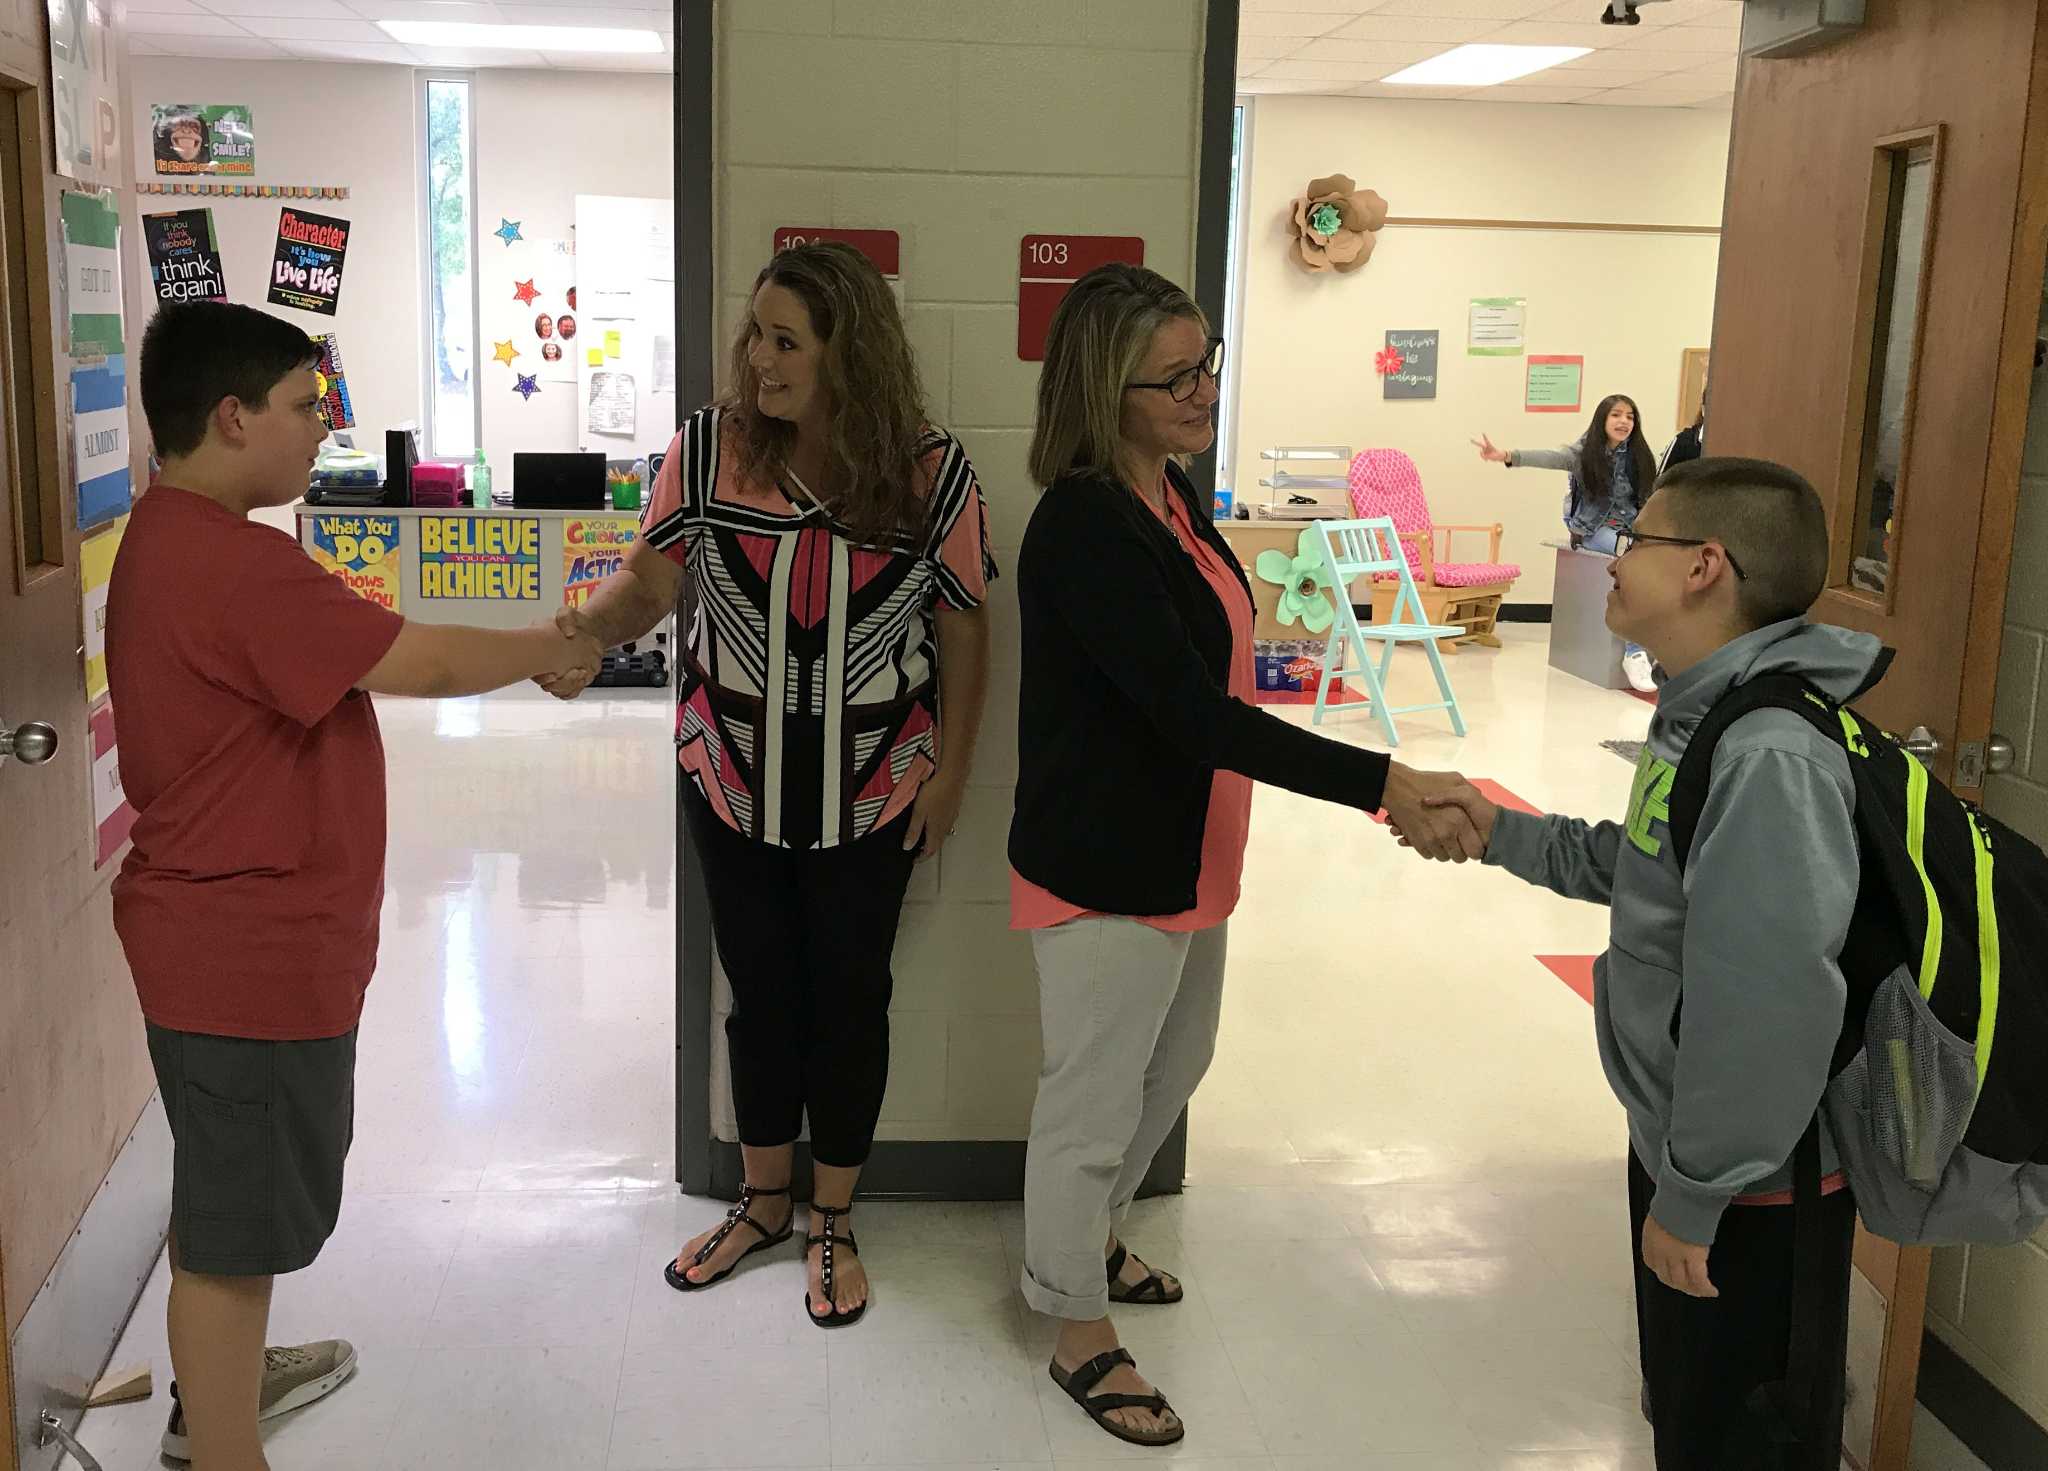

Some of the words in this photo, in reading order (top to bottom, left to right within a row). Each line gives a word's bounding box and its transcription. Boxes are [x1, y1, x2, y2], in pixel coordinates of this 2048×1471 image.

[212, 142, 252, 157] SMILE?
[167, 229, 190, 240] think
[171, 220, 188, 232] you
[162, 237, 198, 249] nobody
[1028, 242, 1068, 264] 103
[298, 256, 319, 267] you
[308, 248, 331, 262] how
[161, 253, 214, 281] think
[276, 260, 307, 288] Live
[309, 266, 338, 295] Life
[160, 272, 223, 304] again!
[85, 428, 119, 457] ALMOST
[320, 516, 361, 535] What
[363, 517, 392, 536] You
[421, 517, 538, 555] BELIEVE
[587, 520, 618, 532] YOUR
[334, 535, 385, 565] DO
[455, 554, 478, 562] YOU
[482, 554, 506, 562] CAN
[421, 562, 538, 598] ACHIEVE
